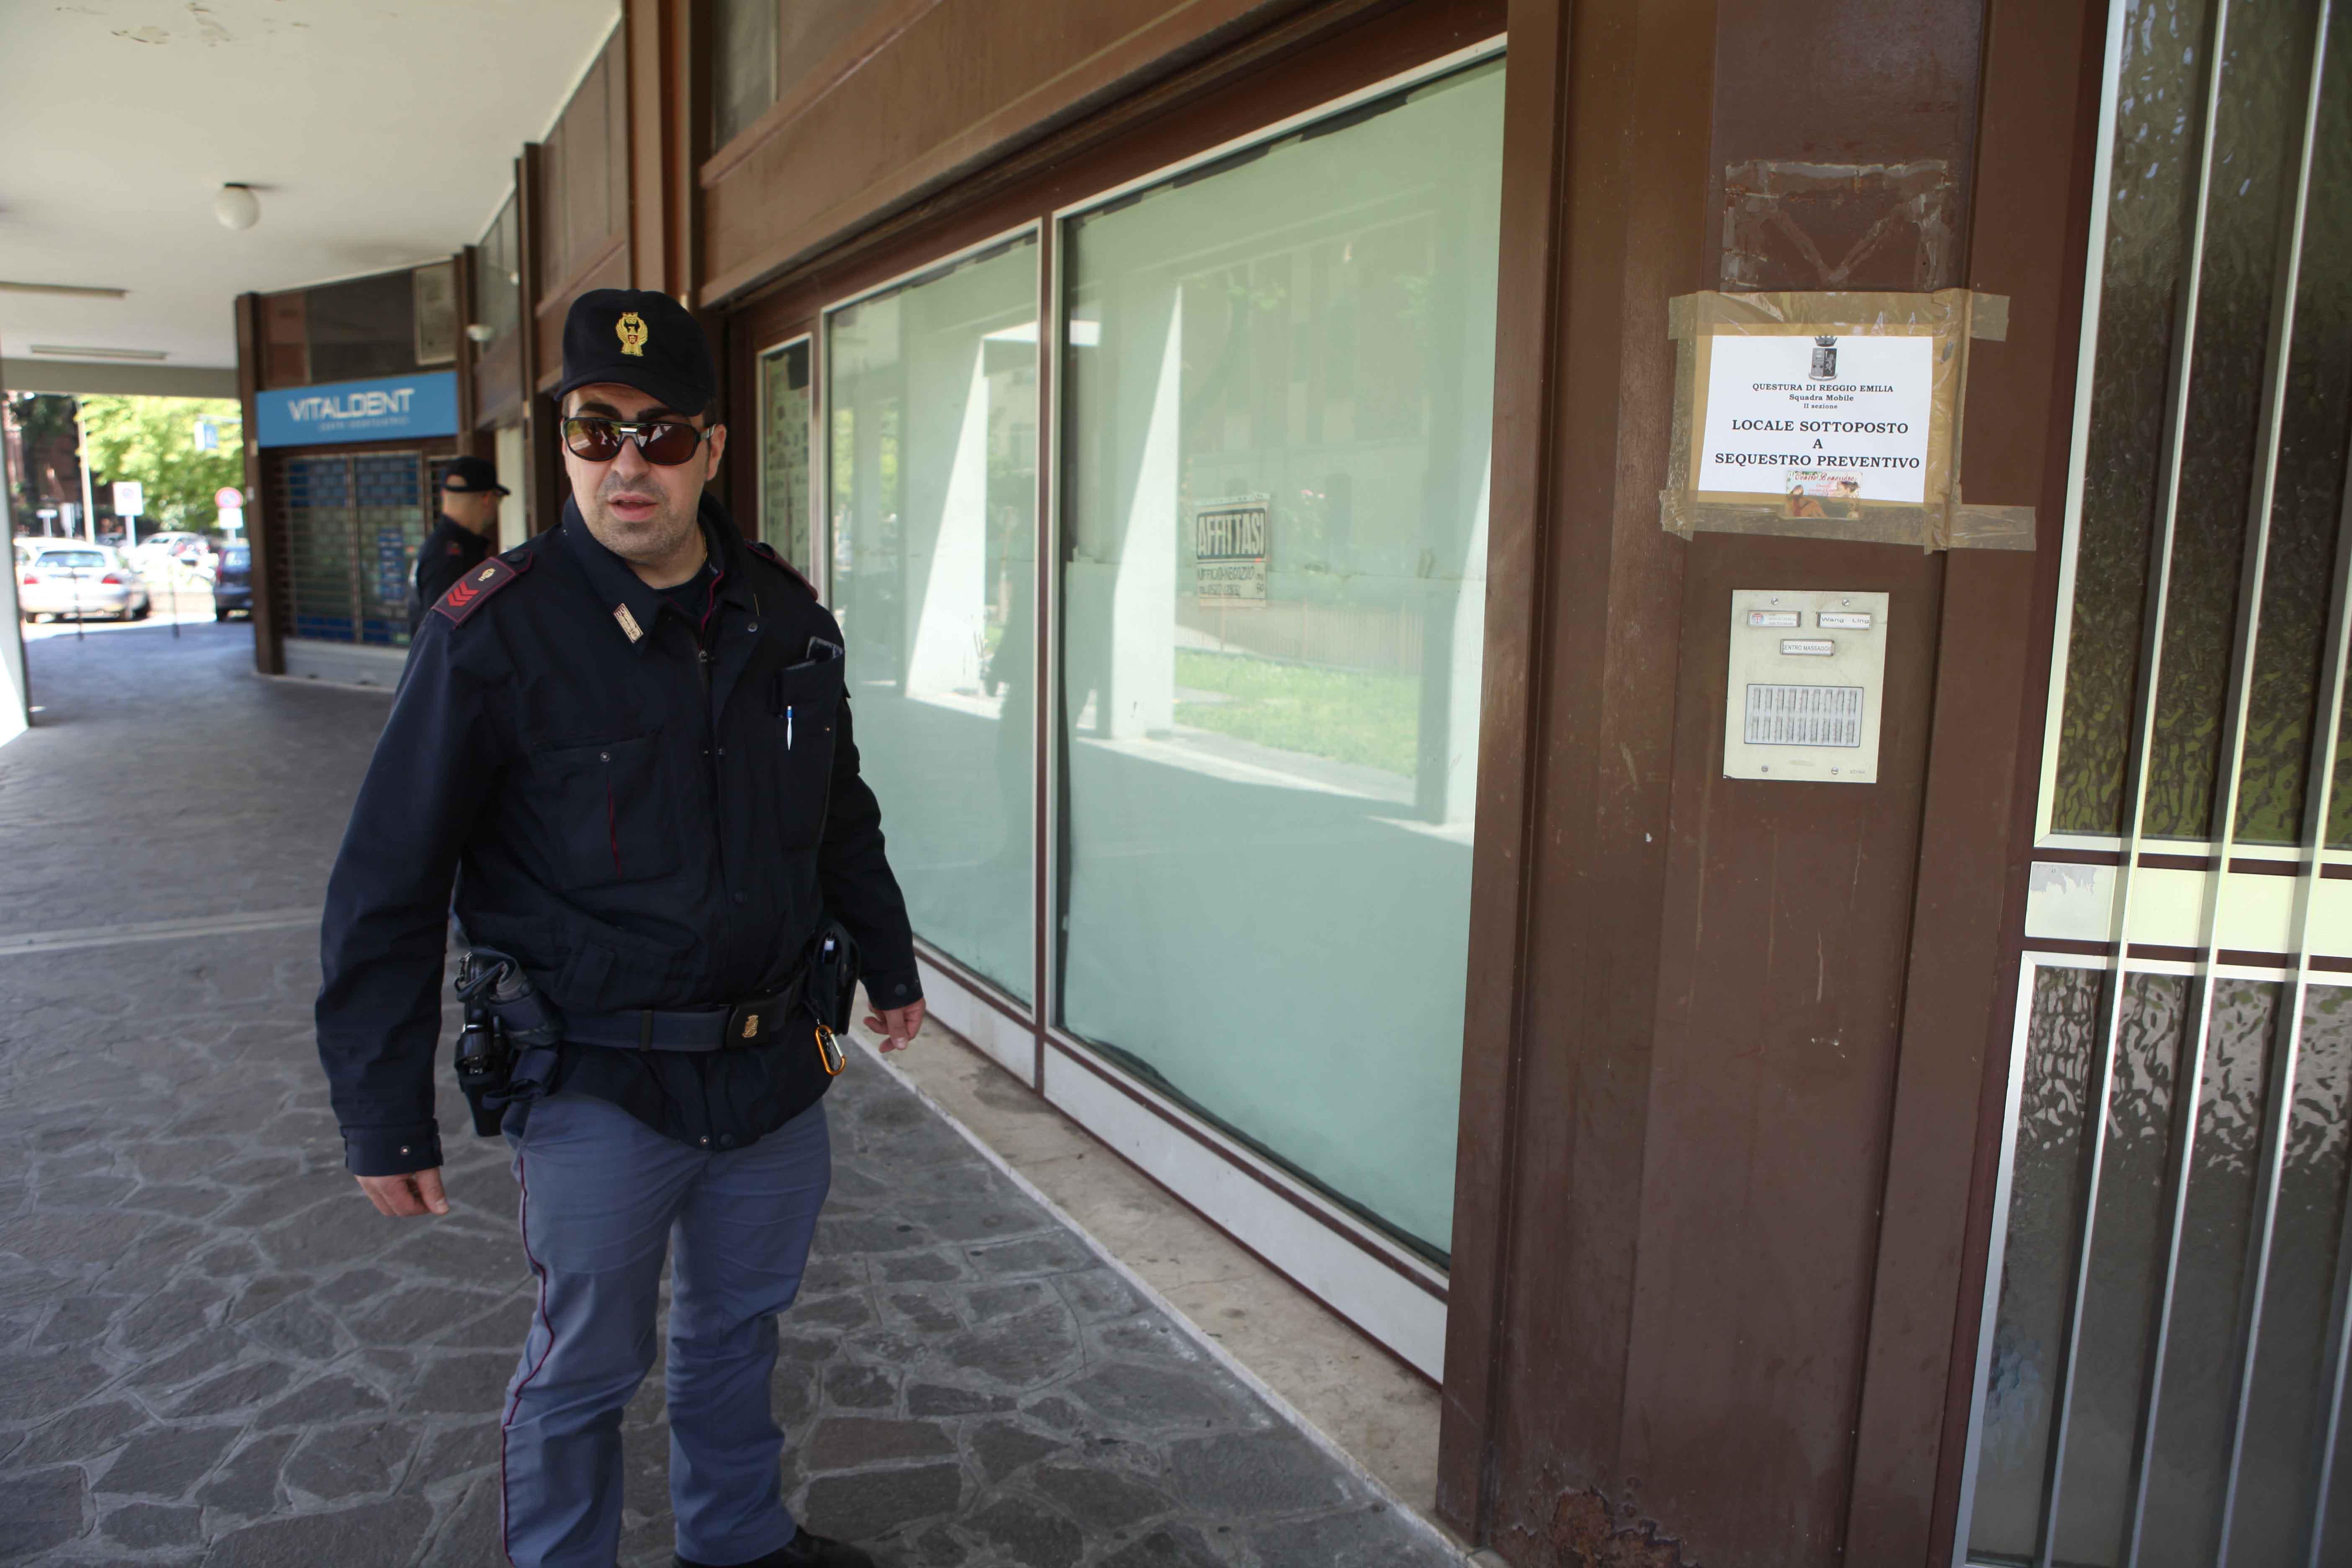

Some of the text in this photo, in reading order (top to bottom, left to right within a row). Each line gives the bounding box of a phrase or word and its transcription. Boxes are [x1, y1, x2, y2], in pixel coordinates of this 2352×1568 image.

[1752, 383, 1803, 392] QUESTURA
[287, 388, 415, 422] VITALDENT
[1732, 419, 1908, 433] LOCALE SOTTOPOSTO
[1812, 438, 1823, 449] A
[1715, 453, 1920, 468] SEQUESTRO PREVENTIVO
[1795, 472, 1818, 481] Centro
[1198, 512, 1264, 556] AFFITTASI
